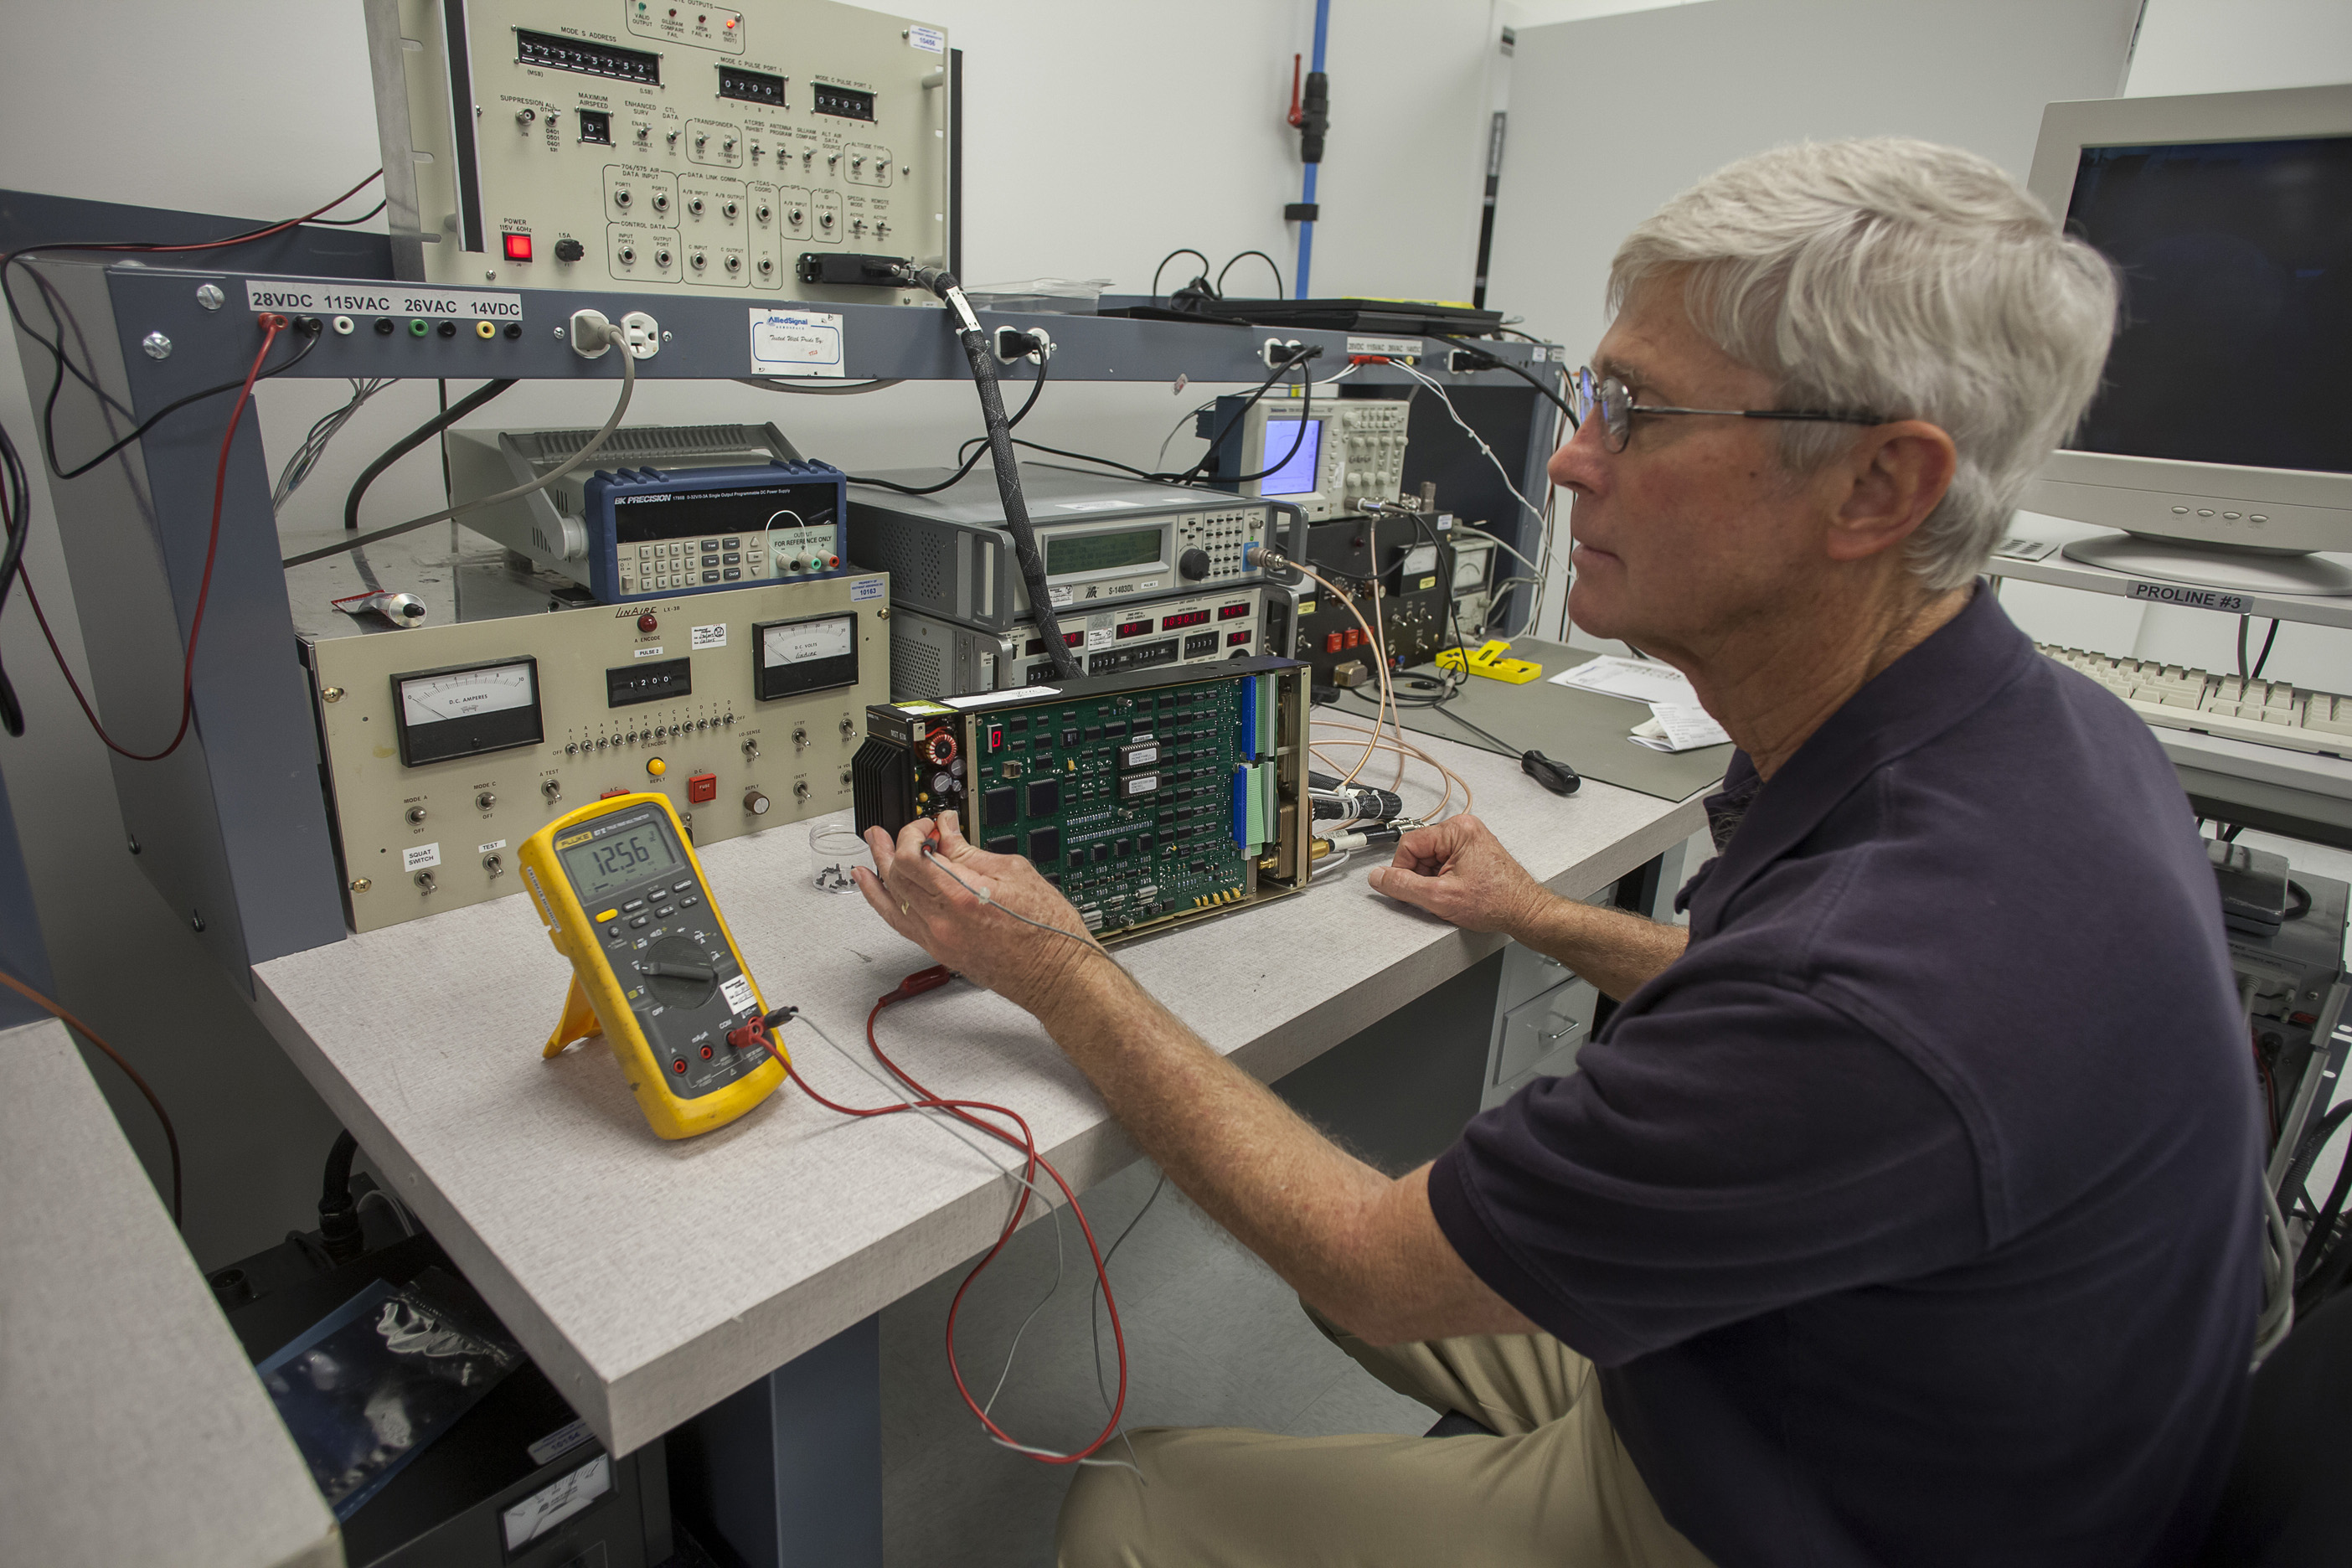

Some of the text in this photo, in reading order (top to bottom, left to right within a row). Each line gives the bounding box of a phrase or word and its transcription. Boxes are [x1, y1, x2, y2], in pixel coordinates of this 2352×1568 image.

[561, 27, 578, 35] MODE
[590, 32, 616, 42] ADDRESS
[720, 57, 735, 65] MODE
[745, 60, 761, 70] PULSE
[763, 64, 777, 72] PORT
[500, 95, 544, 107] SUPPRESSION
[578, 92, 608, 101] MAXIMUM
[579, 100, 609, 109] AIRSPEED
[625, 101, 657, 111] ENHANCED
[663, 112, 679, 121] DATA
[694, 117, 733, 128] TRANSPONDER
[621, 220, 647, 229] CONTROL
[253, 292, 520, 316] 28VDC 115VAC 26VAC 14VDC
[768, 317, 808, 326] AlliedSignal
[627, 494, 672, 504] PRECISION
[787, 537, 818, 545] REFERENCE
[1108, 584, 1134, 596] S-1403DL
[2136, 585, 2241, 609] PROLINE #3
[462, 694, 488, 703] AMPERES
[561, 833, 590, 847] FLUKE
[409, 849, 431, 859] SQUAT
[409, 856, 434, 865] SWITCH
[652, 1006, 664, 1017] OFF
[719, 1019, 733, 1030] COM
